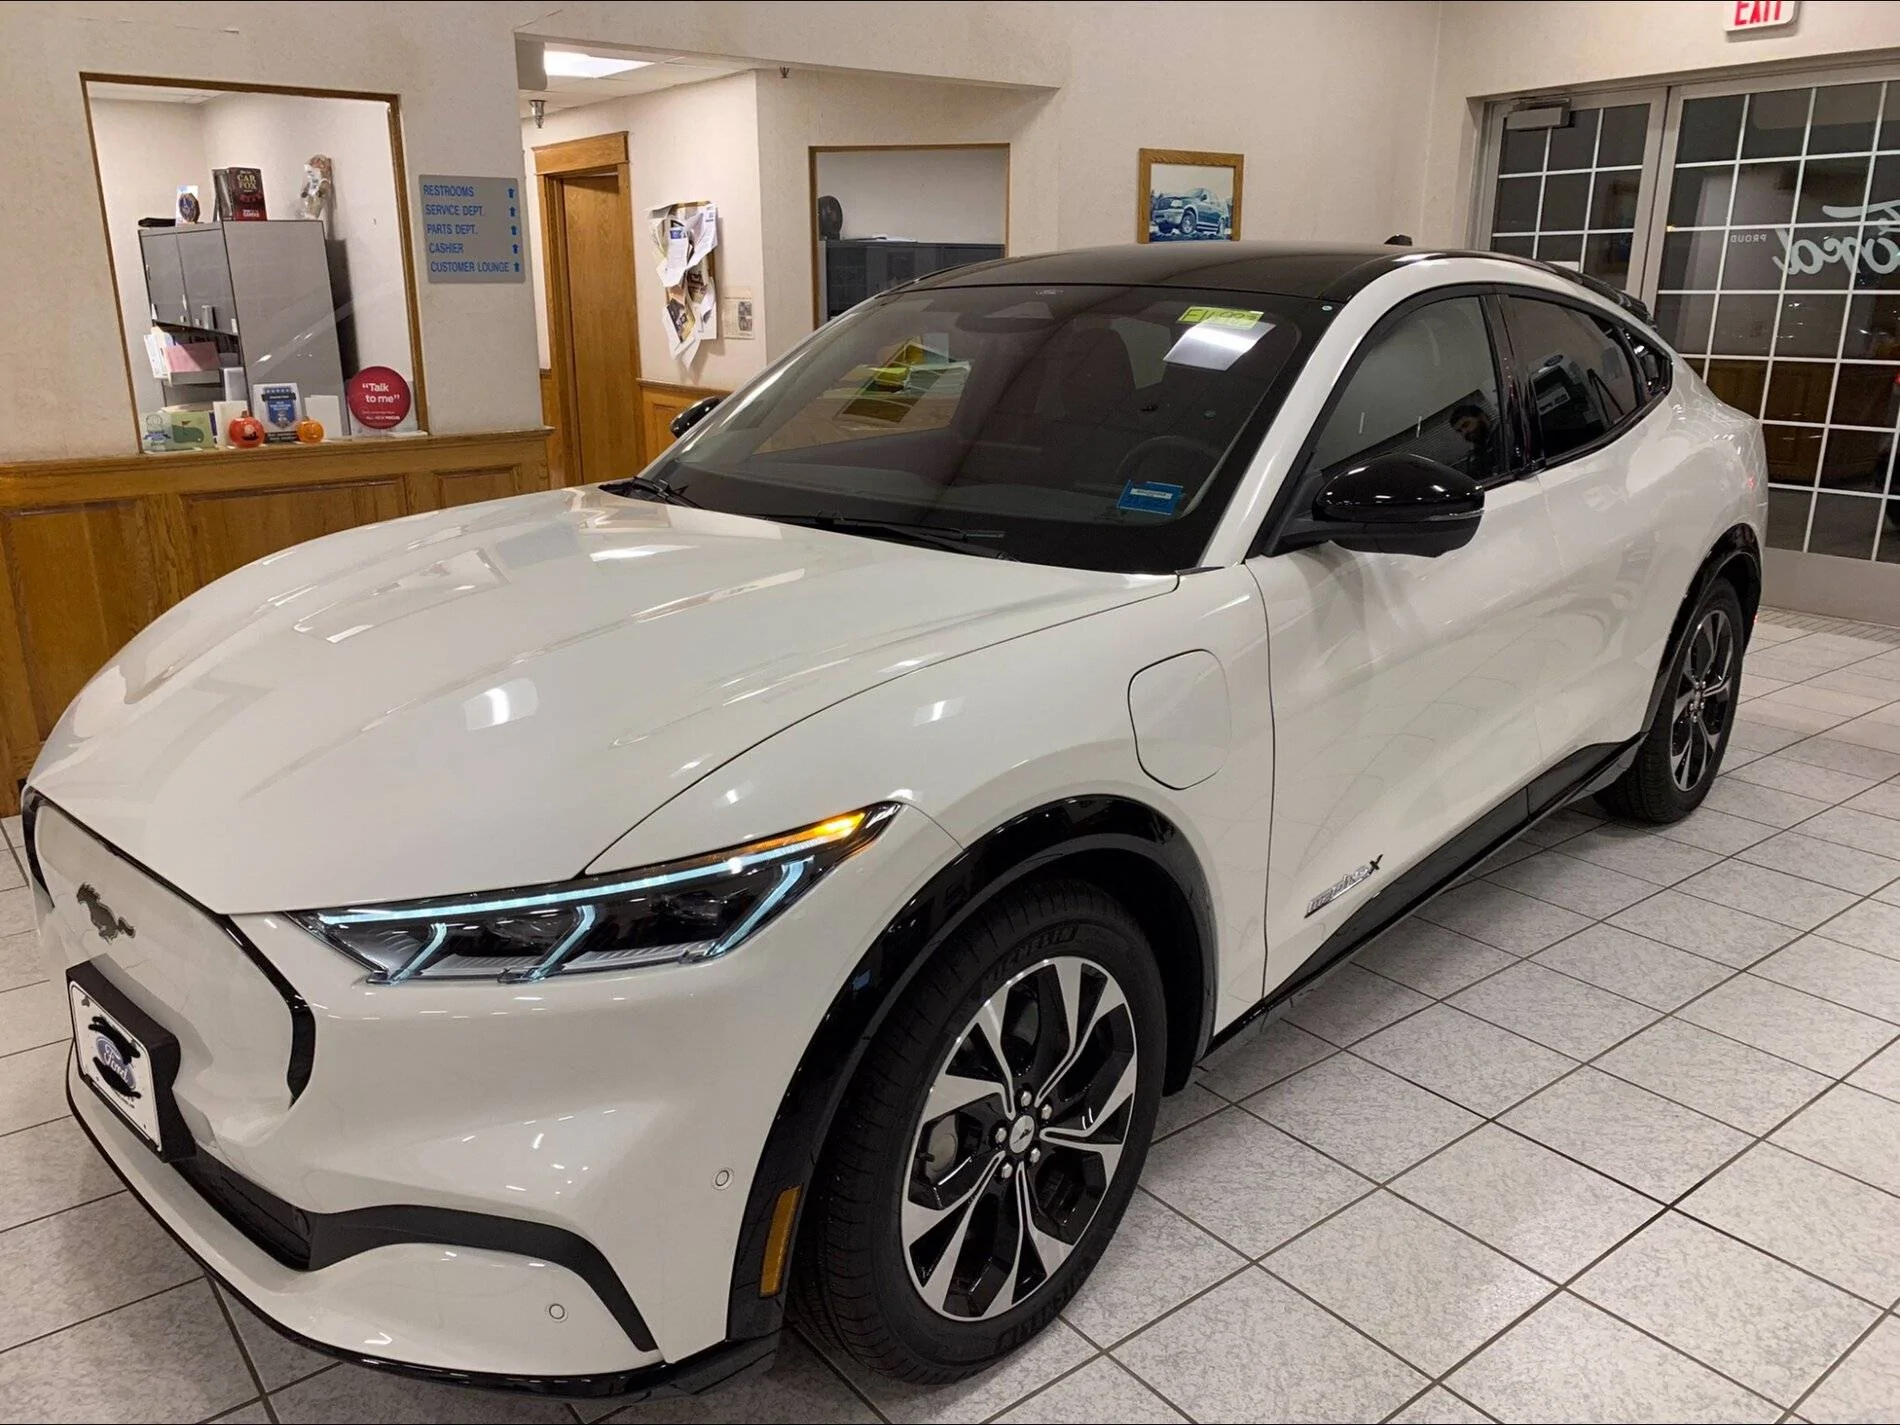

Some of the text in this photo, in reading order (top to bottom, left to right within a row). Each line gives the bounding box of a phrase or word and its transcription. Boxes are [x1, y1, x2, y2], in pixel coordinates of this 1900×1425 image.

[423, 184, 475, 197] RESTROOMS
[425, 203, 485, 217] SERVICE DEPT.
[427, 223, 479, 235] PARTS DEPT.
[430, 261, 510, 273] CUSTOMER LOUNGE
[365, 394, 377, 404] to
